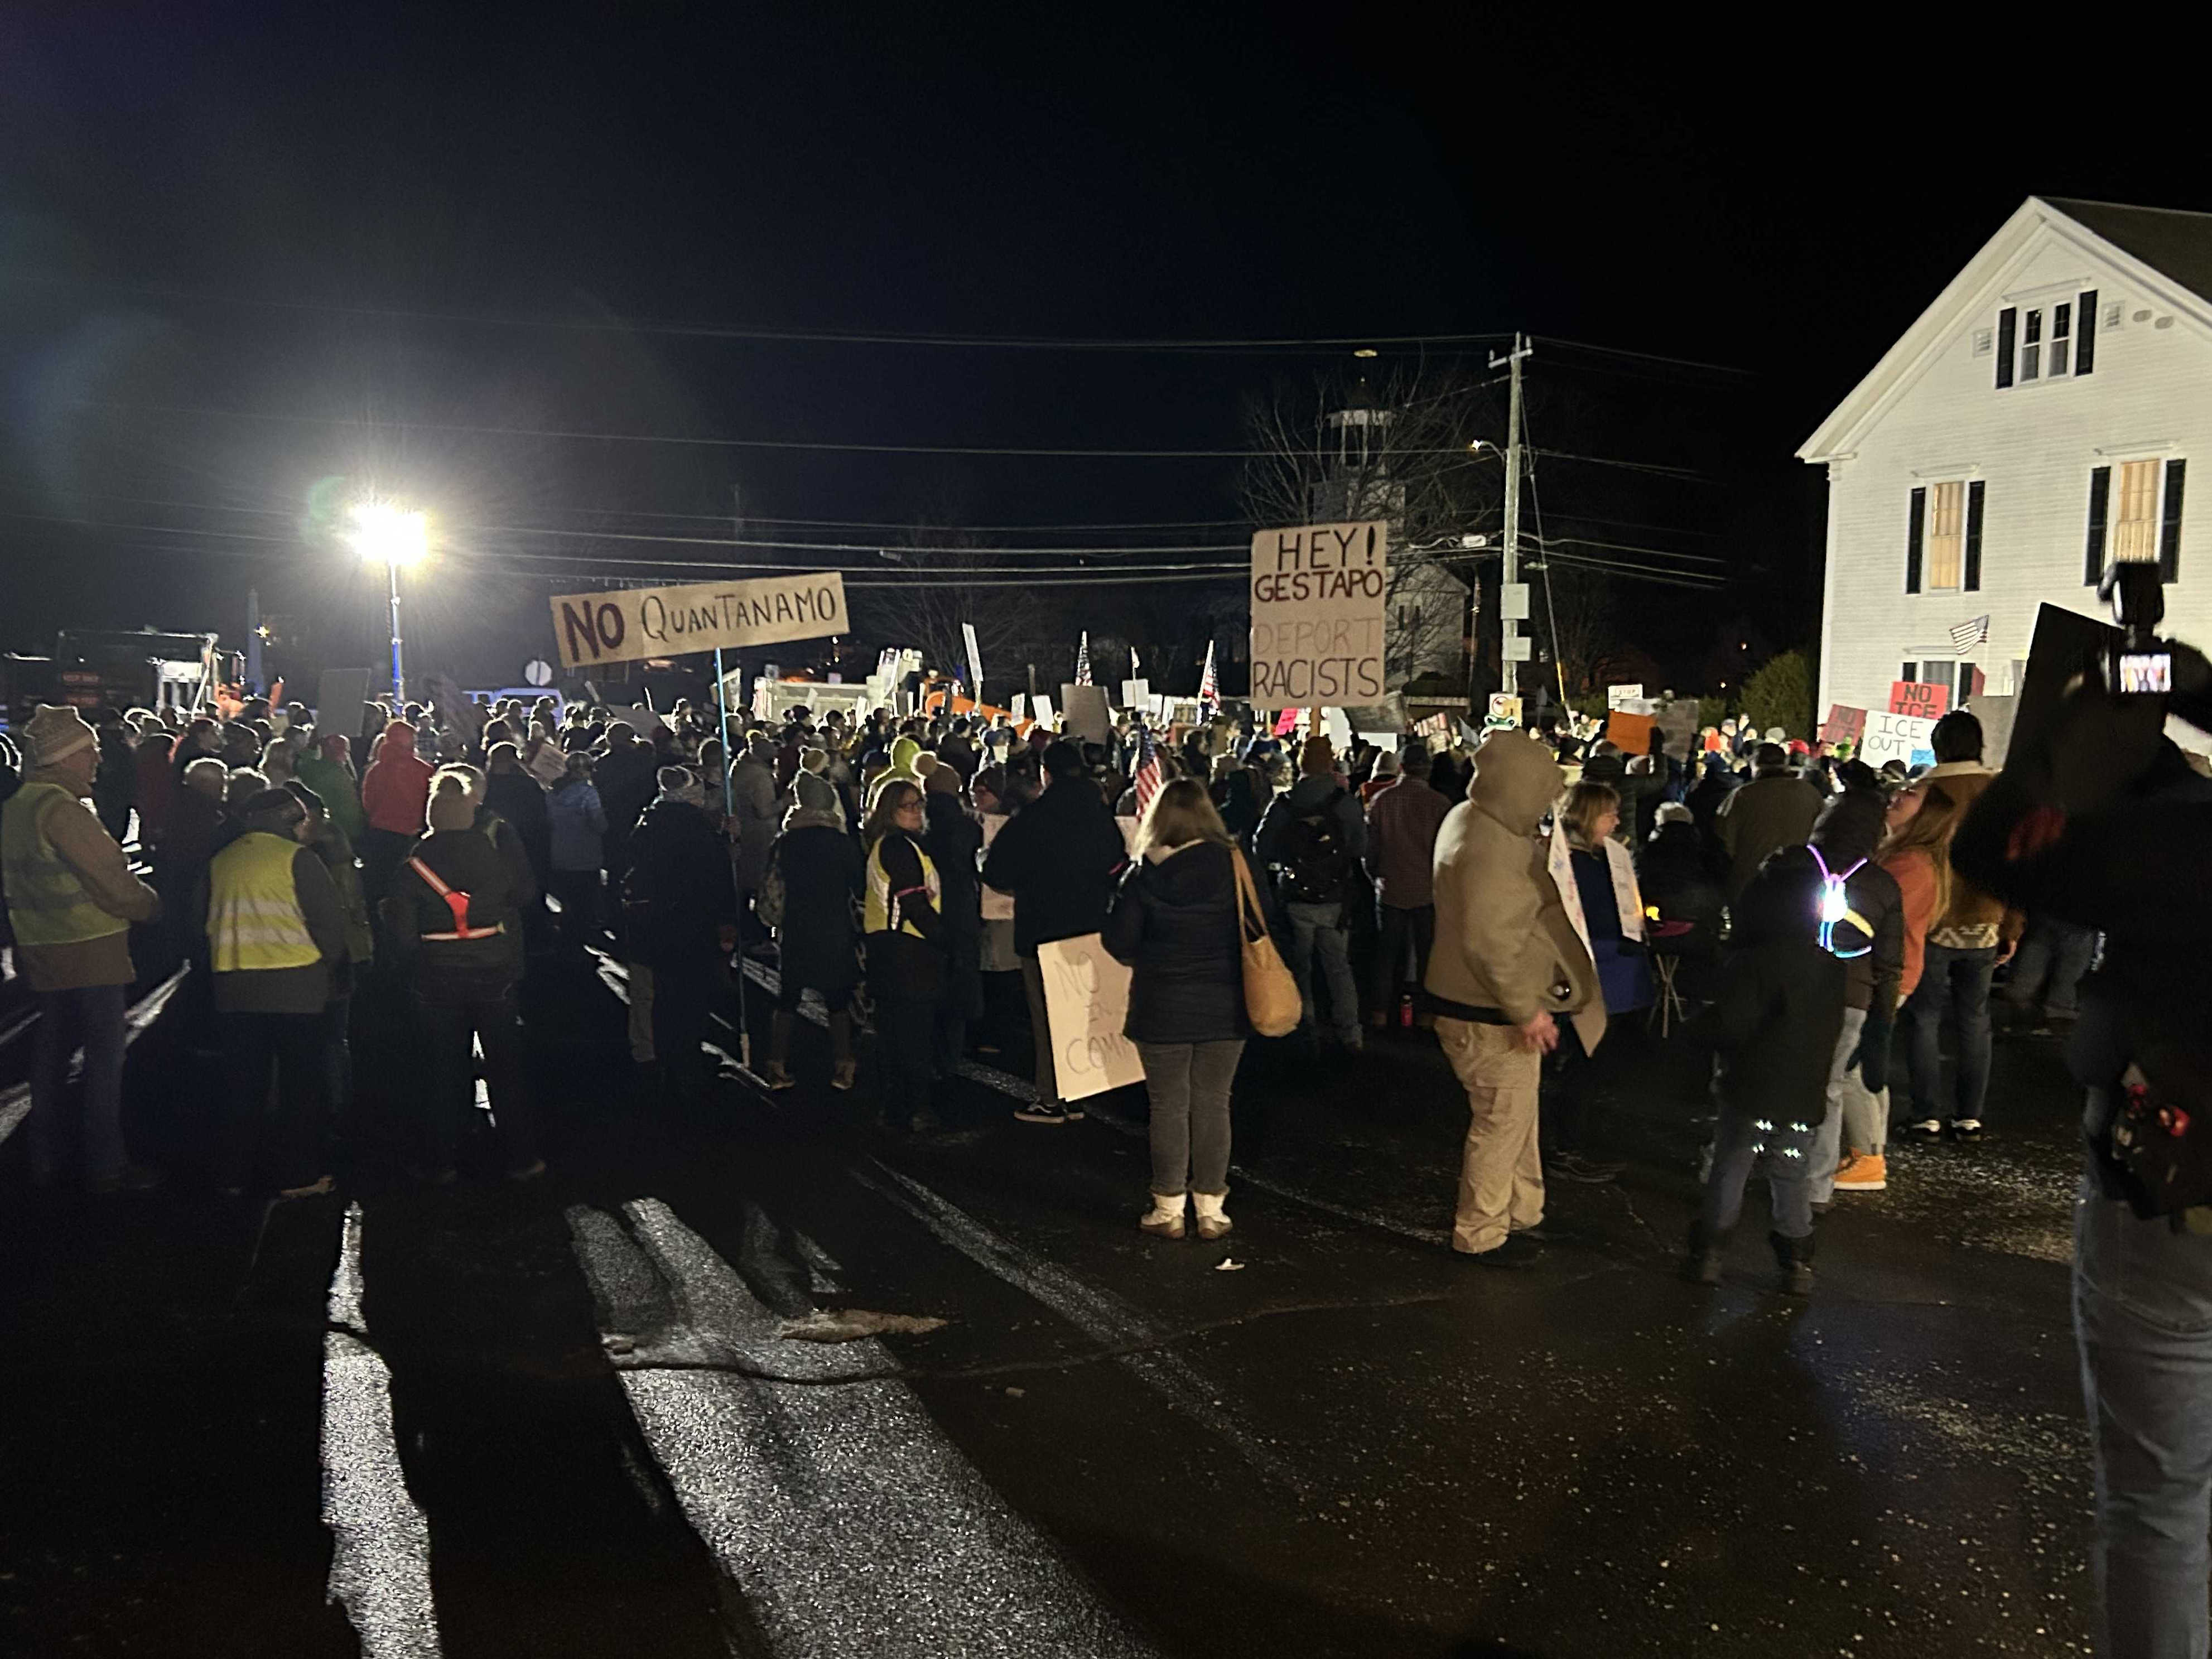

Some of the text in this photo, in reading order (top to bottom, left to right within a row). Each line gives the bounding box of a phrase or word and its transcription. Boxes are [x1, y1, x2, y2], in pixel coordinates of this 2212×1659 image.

[1278, 525, 1376, 571] HEY!
[1255, 569, 1383, 602] GESTAPO
[562, 587, 836, 662] NO QUANTANAMO
[1254, 617, 1381, 655] DEPORT
[1253, 658, 1379, 699] RACISTS
[1903, 684, 1932, 703] NO
[1878, 715, 1924, 739] ICE
[1894, 701, 1937, 720] ICE
[1868, 735, 1905, 756] OUT
[1053, 951, 1100, 1002] NO
